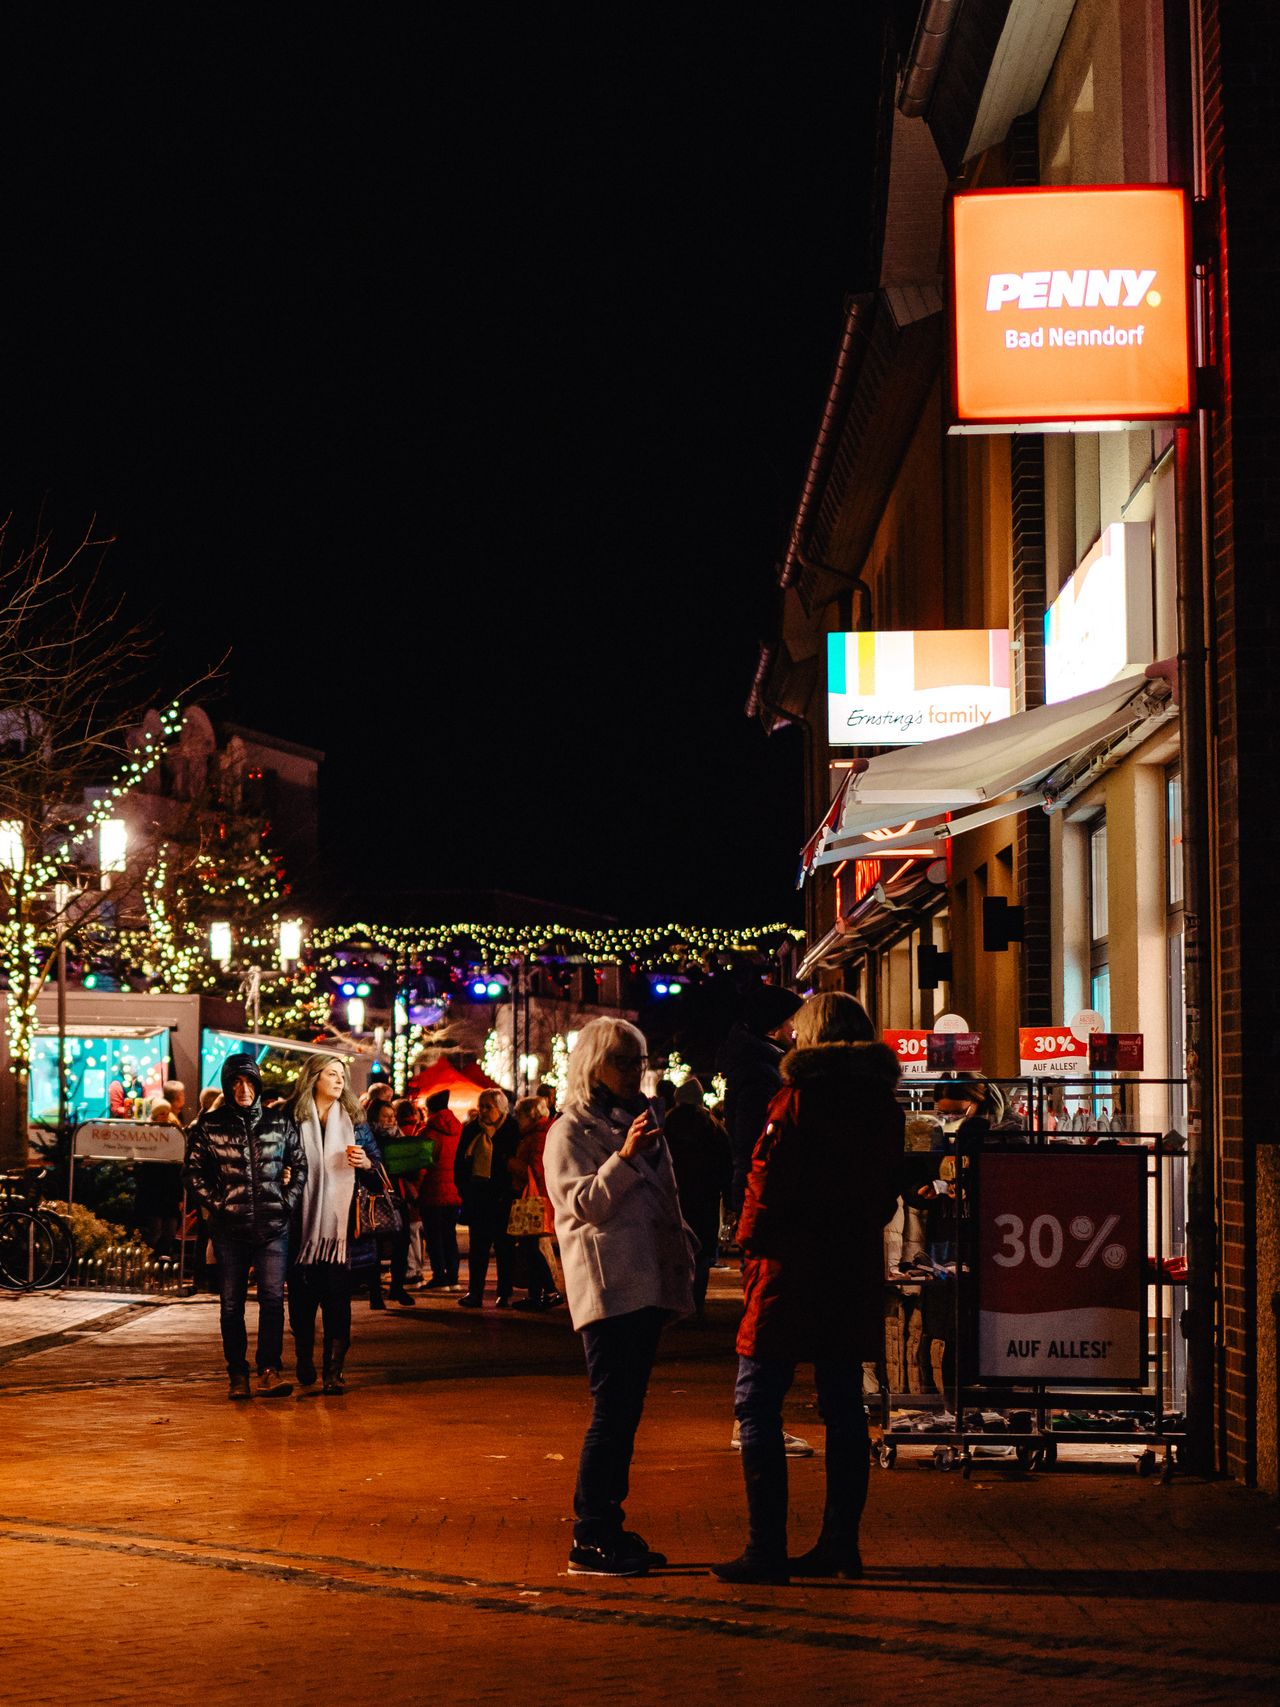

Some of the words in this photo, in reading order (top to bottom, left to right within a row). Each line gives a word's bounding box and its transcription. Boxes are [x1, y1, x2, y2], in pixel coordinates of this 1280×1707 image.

[1005, 327, 1043, 349] Bad
[1049, 325, 1144, 347] Nenndorf
[847, 709, 923, 731] Ernsting's
[928, 704, 991, 725] family
[1033, 1035, 1075, 1053] 30%
[1033, 1063, 1047, 1071] AUF
[92, 1128, 169, 1142] ROSSMANN
[992, 1214, 1127, 1269] 30%
[1007, 1340, 1040, 1358] AUF
